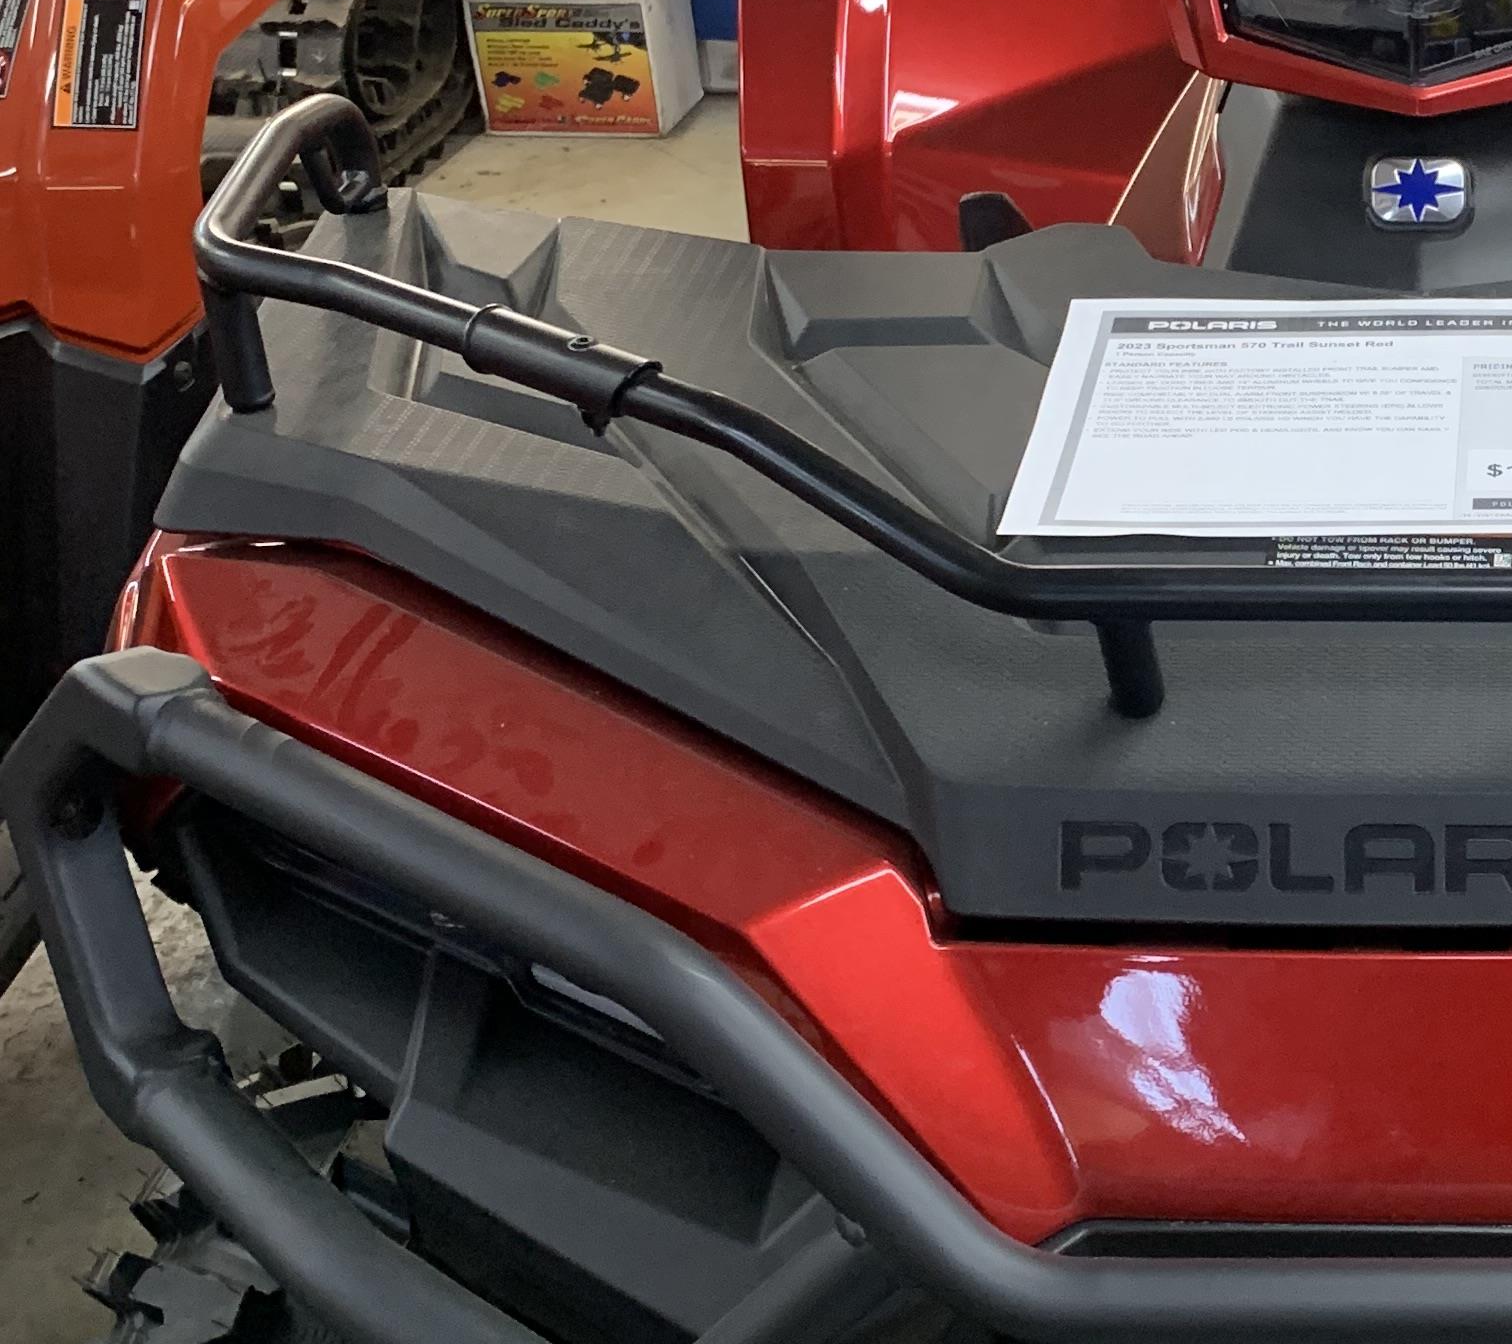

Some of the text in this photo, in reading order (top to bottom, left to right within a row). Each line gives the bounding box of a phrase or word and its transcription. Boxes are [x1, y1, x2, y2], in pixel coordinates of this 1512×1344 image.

[62, 25, 77, 80] WARNING
[1147, 321, 1278, 331] POLARIS
[1117, 342, 1152, 350] 2023
[1156, 342, 1236, 351] Sportsman
[1364, 340, 1394, 348] Red
[1429, 537, 1476, 545] BUMPER.
[1342, 552, 1362, 560] Tow
